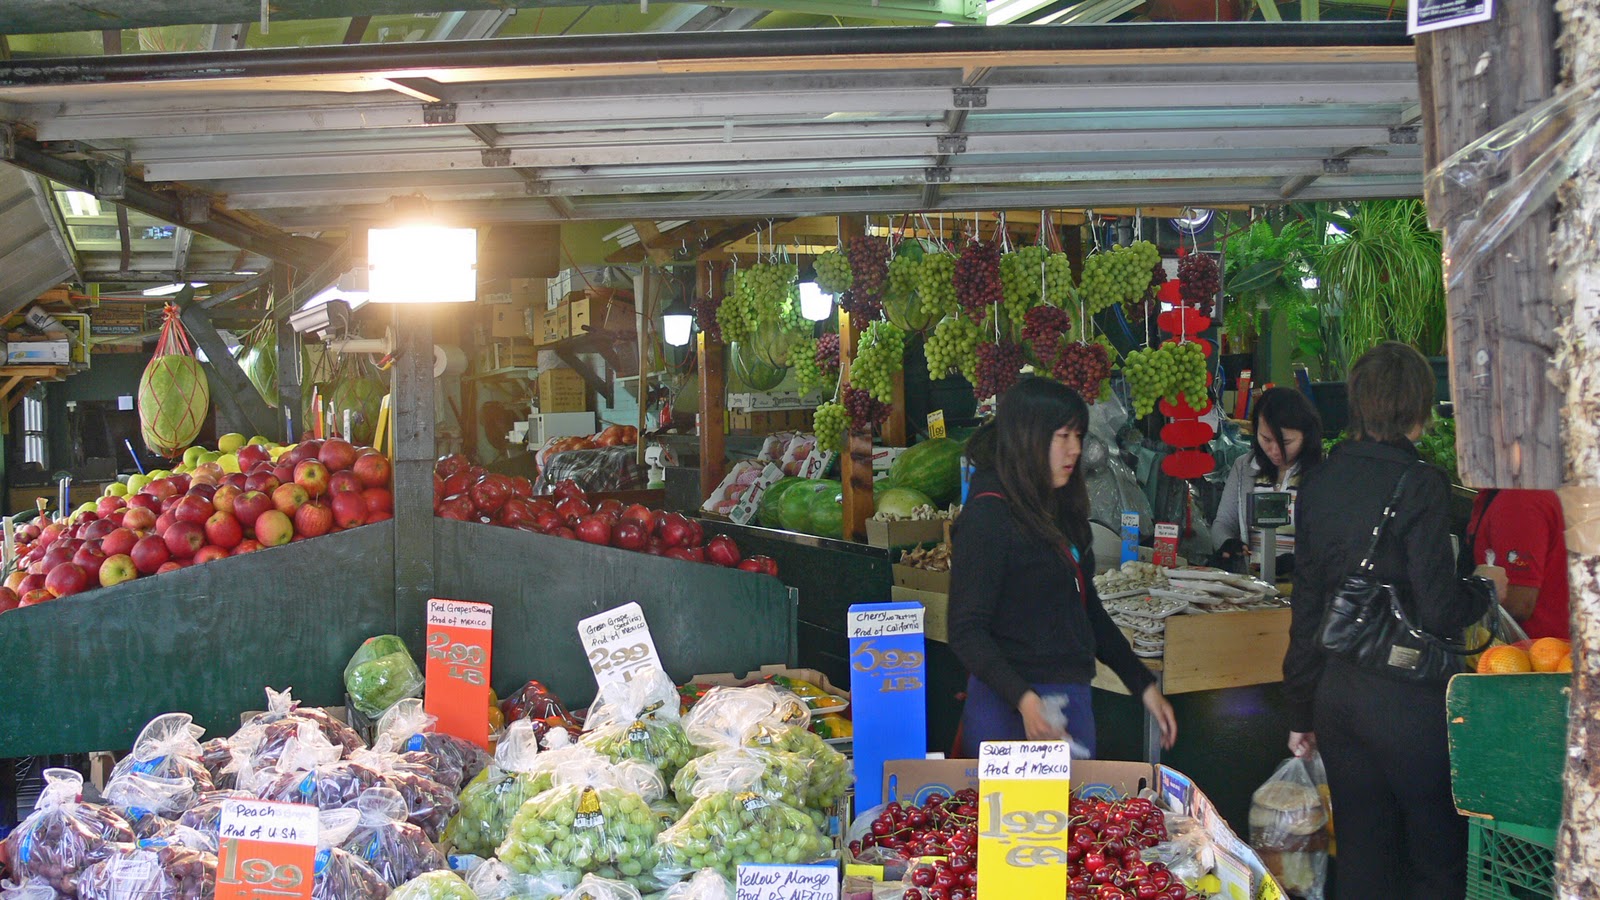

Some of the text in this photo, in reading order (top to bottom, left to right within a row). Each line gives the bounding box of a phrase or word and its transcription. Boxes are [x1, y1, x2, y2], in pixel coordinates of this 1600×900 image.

[431, 602, 445, 612] Red
[448, 616, 457, 626] of
[874, 624, 884, 637] of
[886, 621, 919, 633] California
[1014, 761, 1028, 778] of
[236, 803, 275, 818] Peach
[249, 825, 262, 840] of
[738, 867, 781, 887] Yellow
